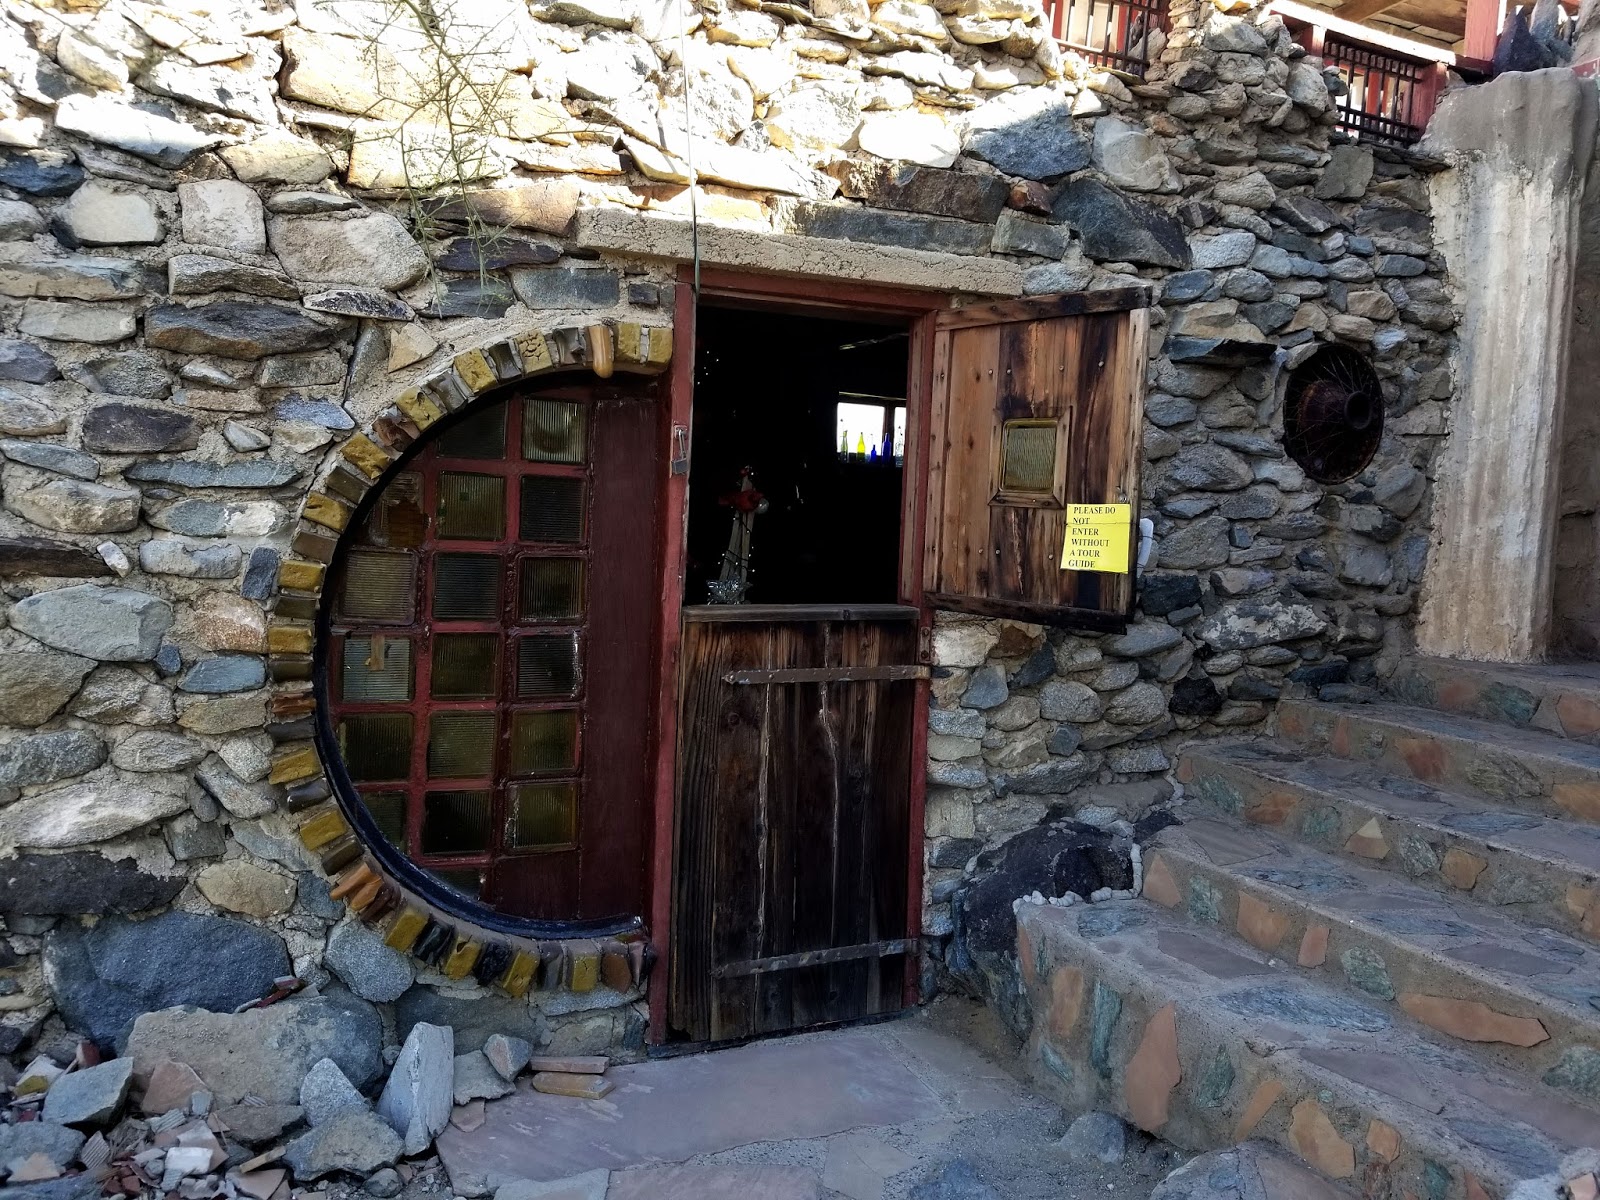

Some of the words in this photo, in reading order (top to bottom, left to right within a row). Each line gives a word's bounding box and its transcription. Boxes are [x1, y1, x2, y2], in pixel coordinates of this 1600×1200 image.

[1073, 506, 1103, 514] PLEASE
[1105, 506, 1116, 514] DO
[1072, 517, 1091, 525] NOT
[1072, 528, 1099, 536] ENTER
[1071, 538, 1110, 547] WITHOUT
[1077, 549, 1100, 558] TOUR
[1068, 559, 1096, 568] GUIDE
